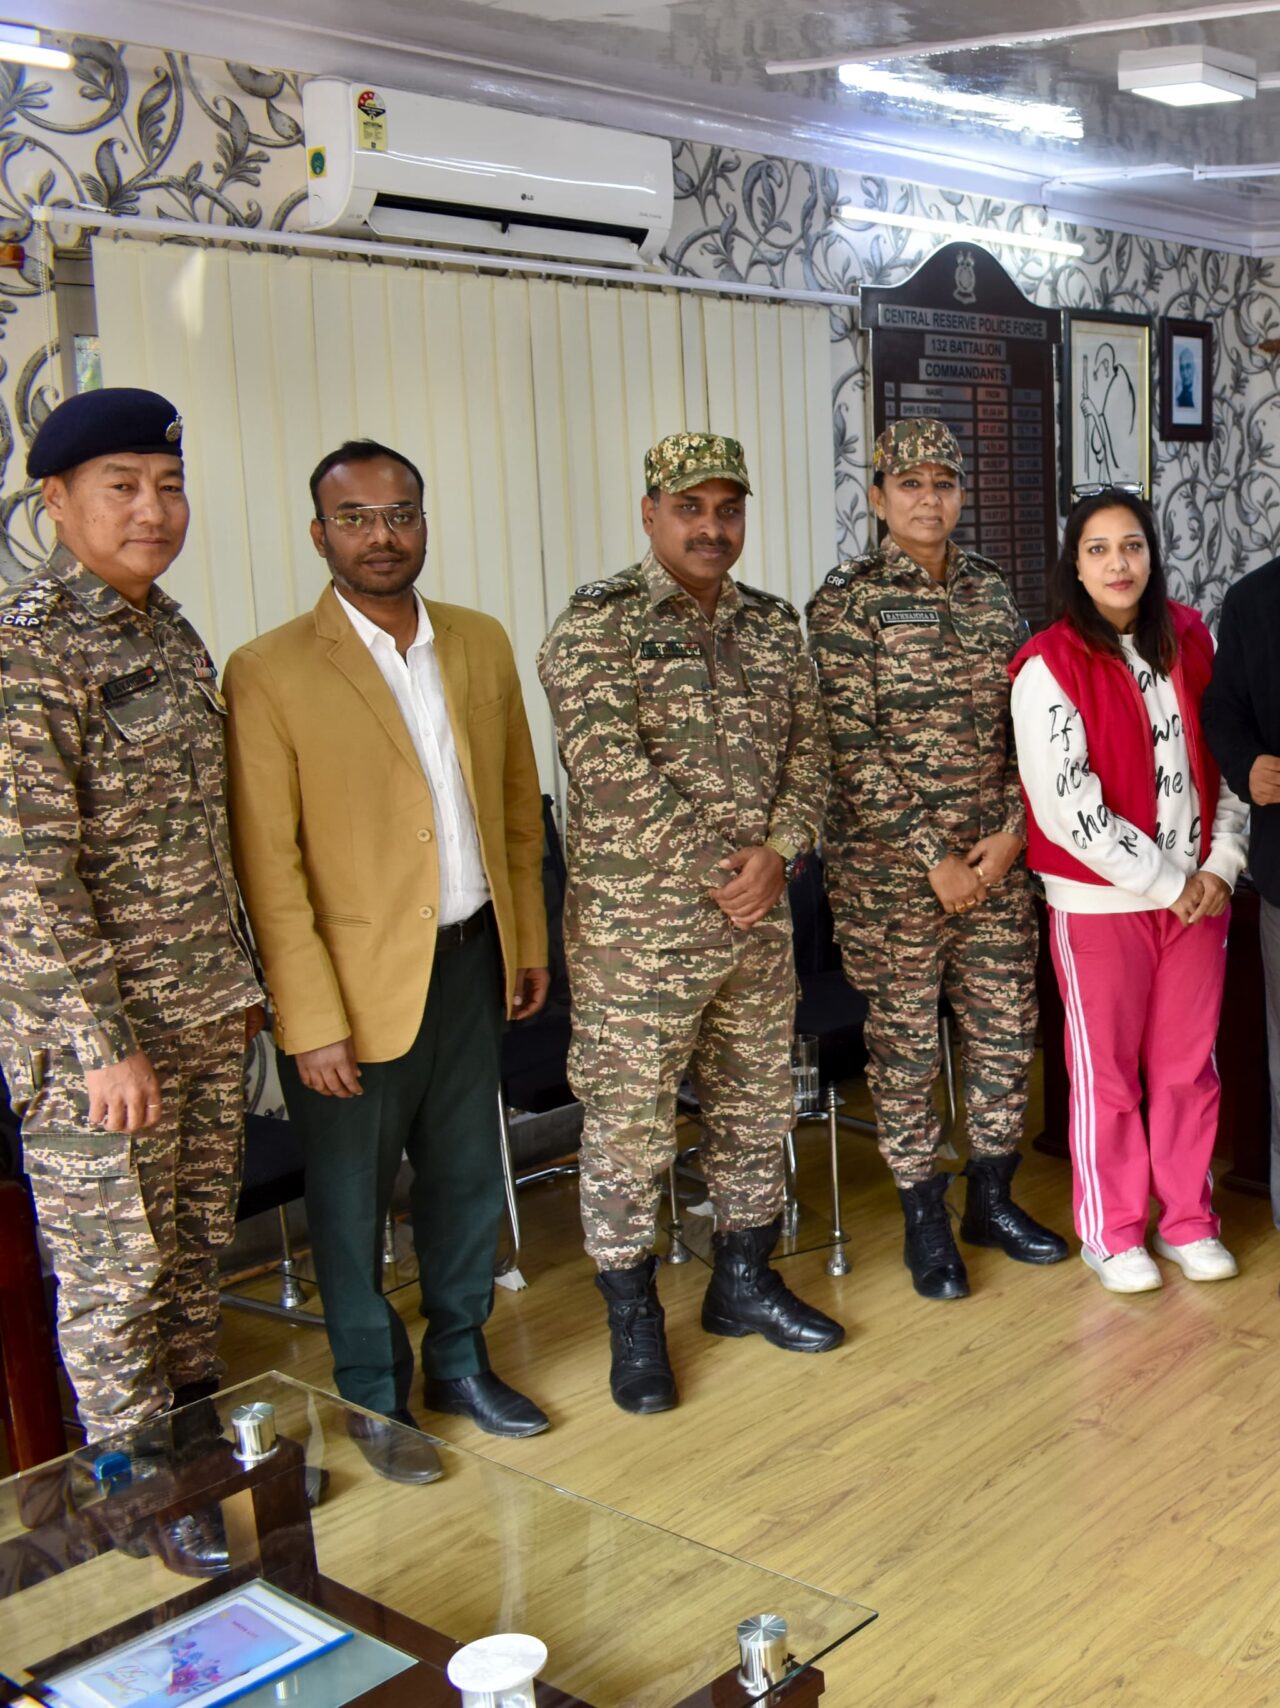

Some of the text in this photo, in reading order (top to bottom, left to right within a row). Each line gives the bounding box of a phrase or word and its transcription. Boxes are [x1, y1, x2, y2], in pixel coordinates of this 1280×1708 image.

[884, 308, 1043, 337] CENTRAL RESERVE POLICE FORCE
[931, 339, 1001, 356] 132 BATTALION
[925, 363, 1007, 380] COMMANDANTS
[827, 575, 845, 587] CRP
[576, 586, 602, 598] CRP
[2, 614, 40, 627] CRP
